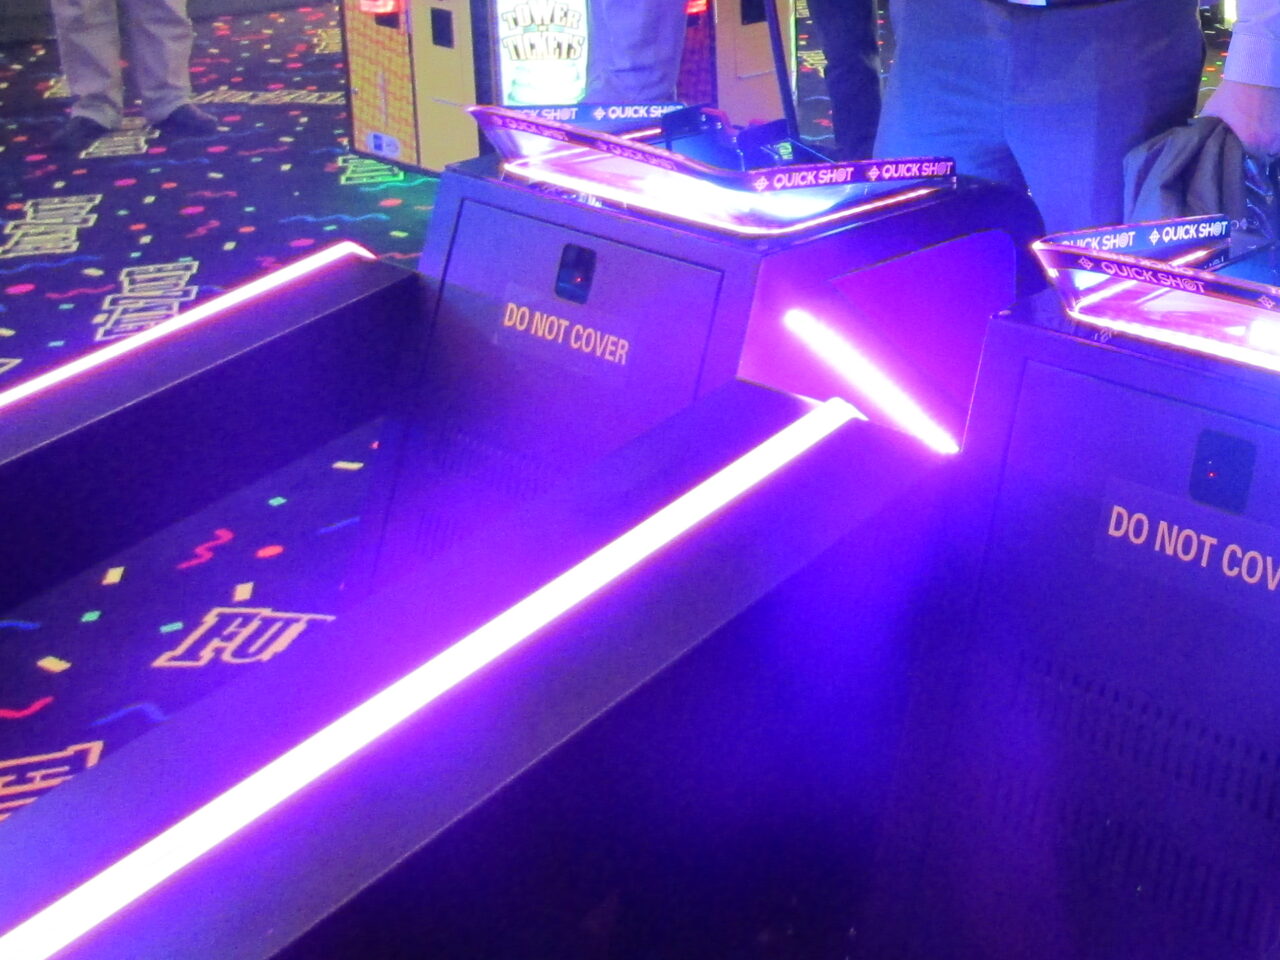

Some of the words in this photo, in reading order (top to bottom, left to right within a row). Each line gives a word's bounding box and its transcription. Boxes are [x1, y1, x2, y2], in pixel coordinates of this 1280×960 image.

[502, 32, 585, 61] TICKETS
[608, 106, 648, 119] QUICK
[773, 170, 817, 189] QUICK
[818, 167, 854, 184] SHOT
[882, 163, 920, 178] QUICK
[921, 162, 953, 176] SHOT
[1102, 231, 1136, 250] SHOT
[1162, 224, 1197, 243] QUICK
[1198, 221, 1228, 237] SHOT
[1101, 262, 1156, 283] QUICK
[1157, 273, 1206, 293] SHOT
[503, 302, 530, 331] DO
[531, 311, 569, 344] NOT
[570, 324, 629, 365] COVER
[1108, 505, 1149, 544] DO
[1154, 520, 1218, 567] NOT
